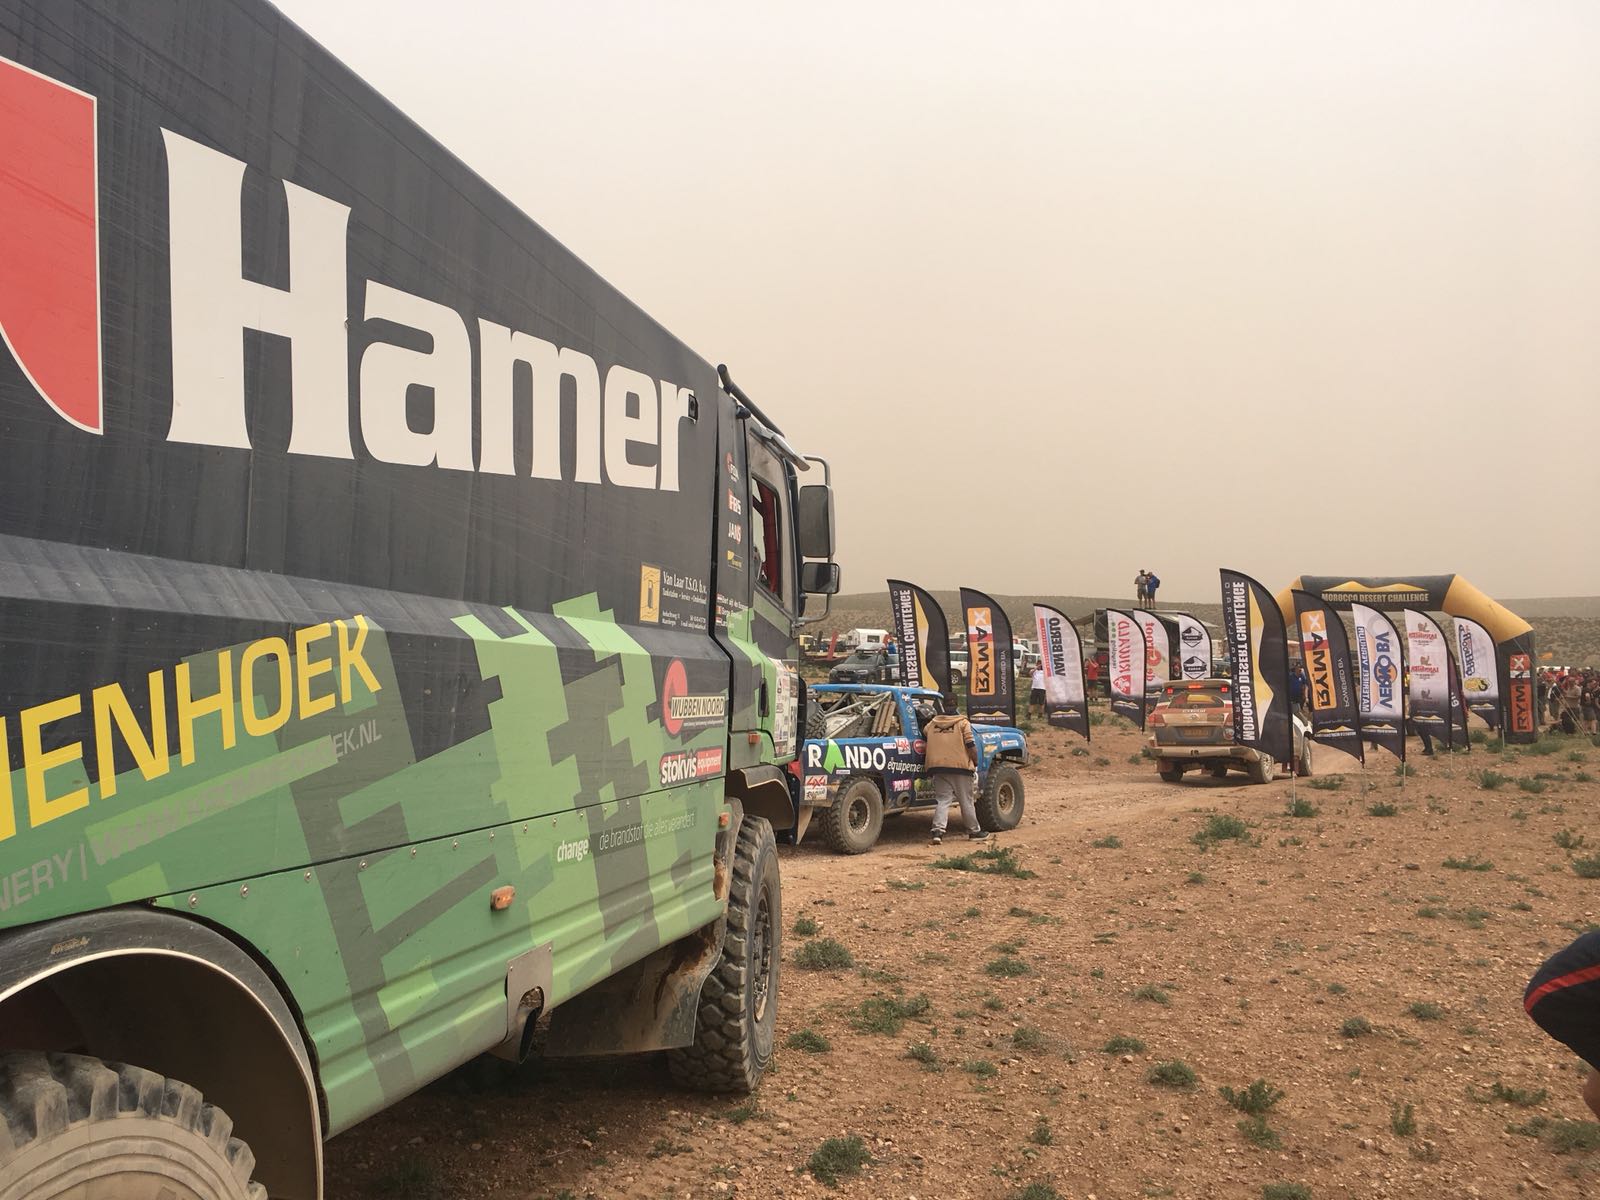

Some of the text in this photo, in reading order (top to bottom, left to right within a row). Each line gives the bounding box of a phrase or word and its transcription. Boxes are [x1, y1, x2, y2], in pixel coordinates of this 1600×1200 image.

[160, 126, 694, 493] Hamer
[663, 571, 673, 585] Van
[673, 574, 684, 588] Laar
[1321, 593, 1429, 602] MOROCCO DESERT CHALLENGE
[672, 698, 724, 717] WUBBEN NOORD
[808, 739, 886, 774] RANDO
[661, 754, 697, 784] stokvis
[557, 838, 589, 862] change
[599, 833, 609, 851] de
